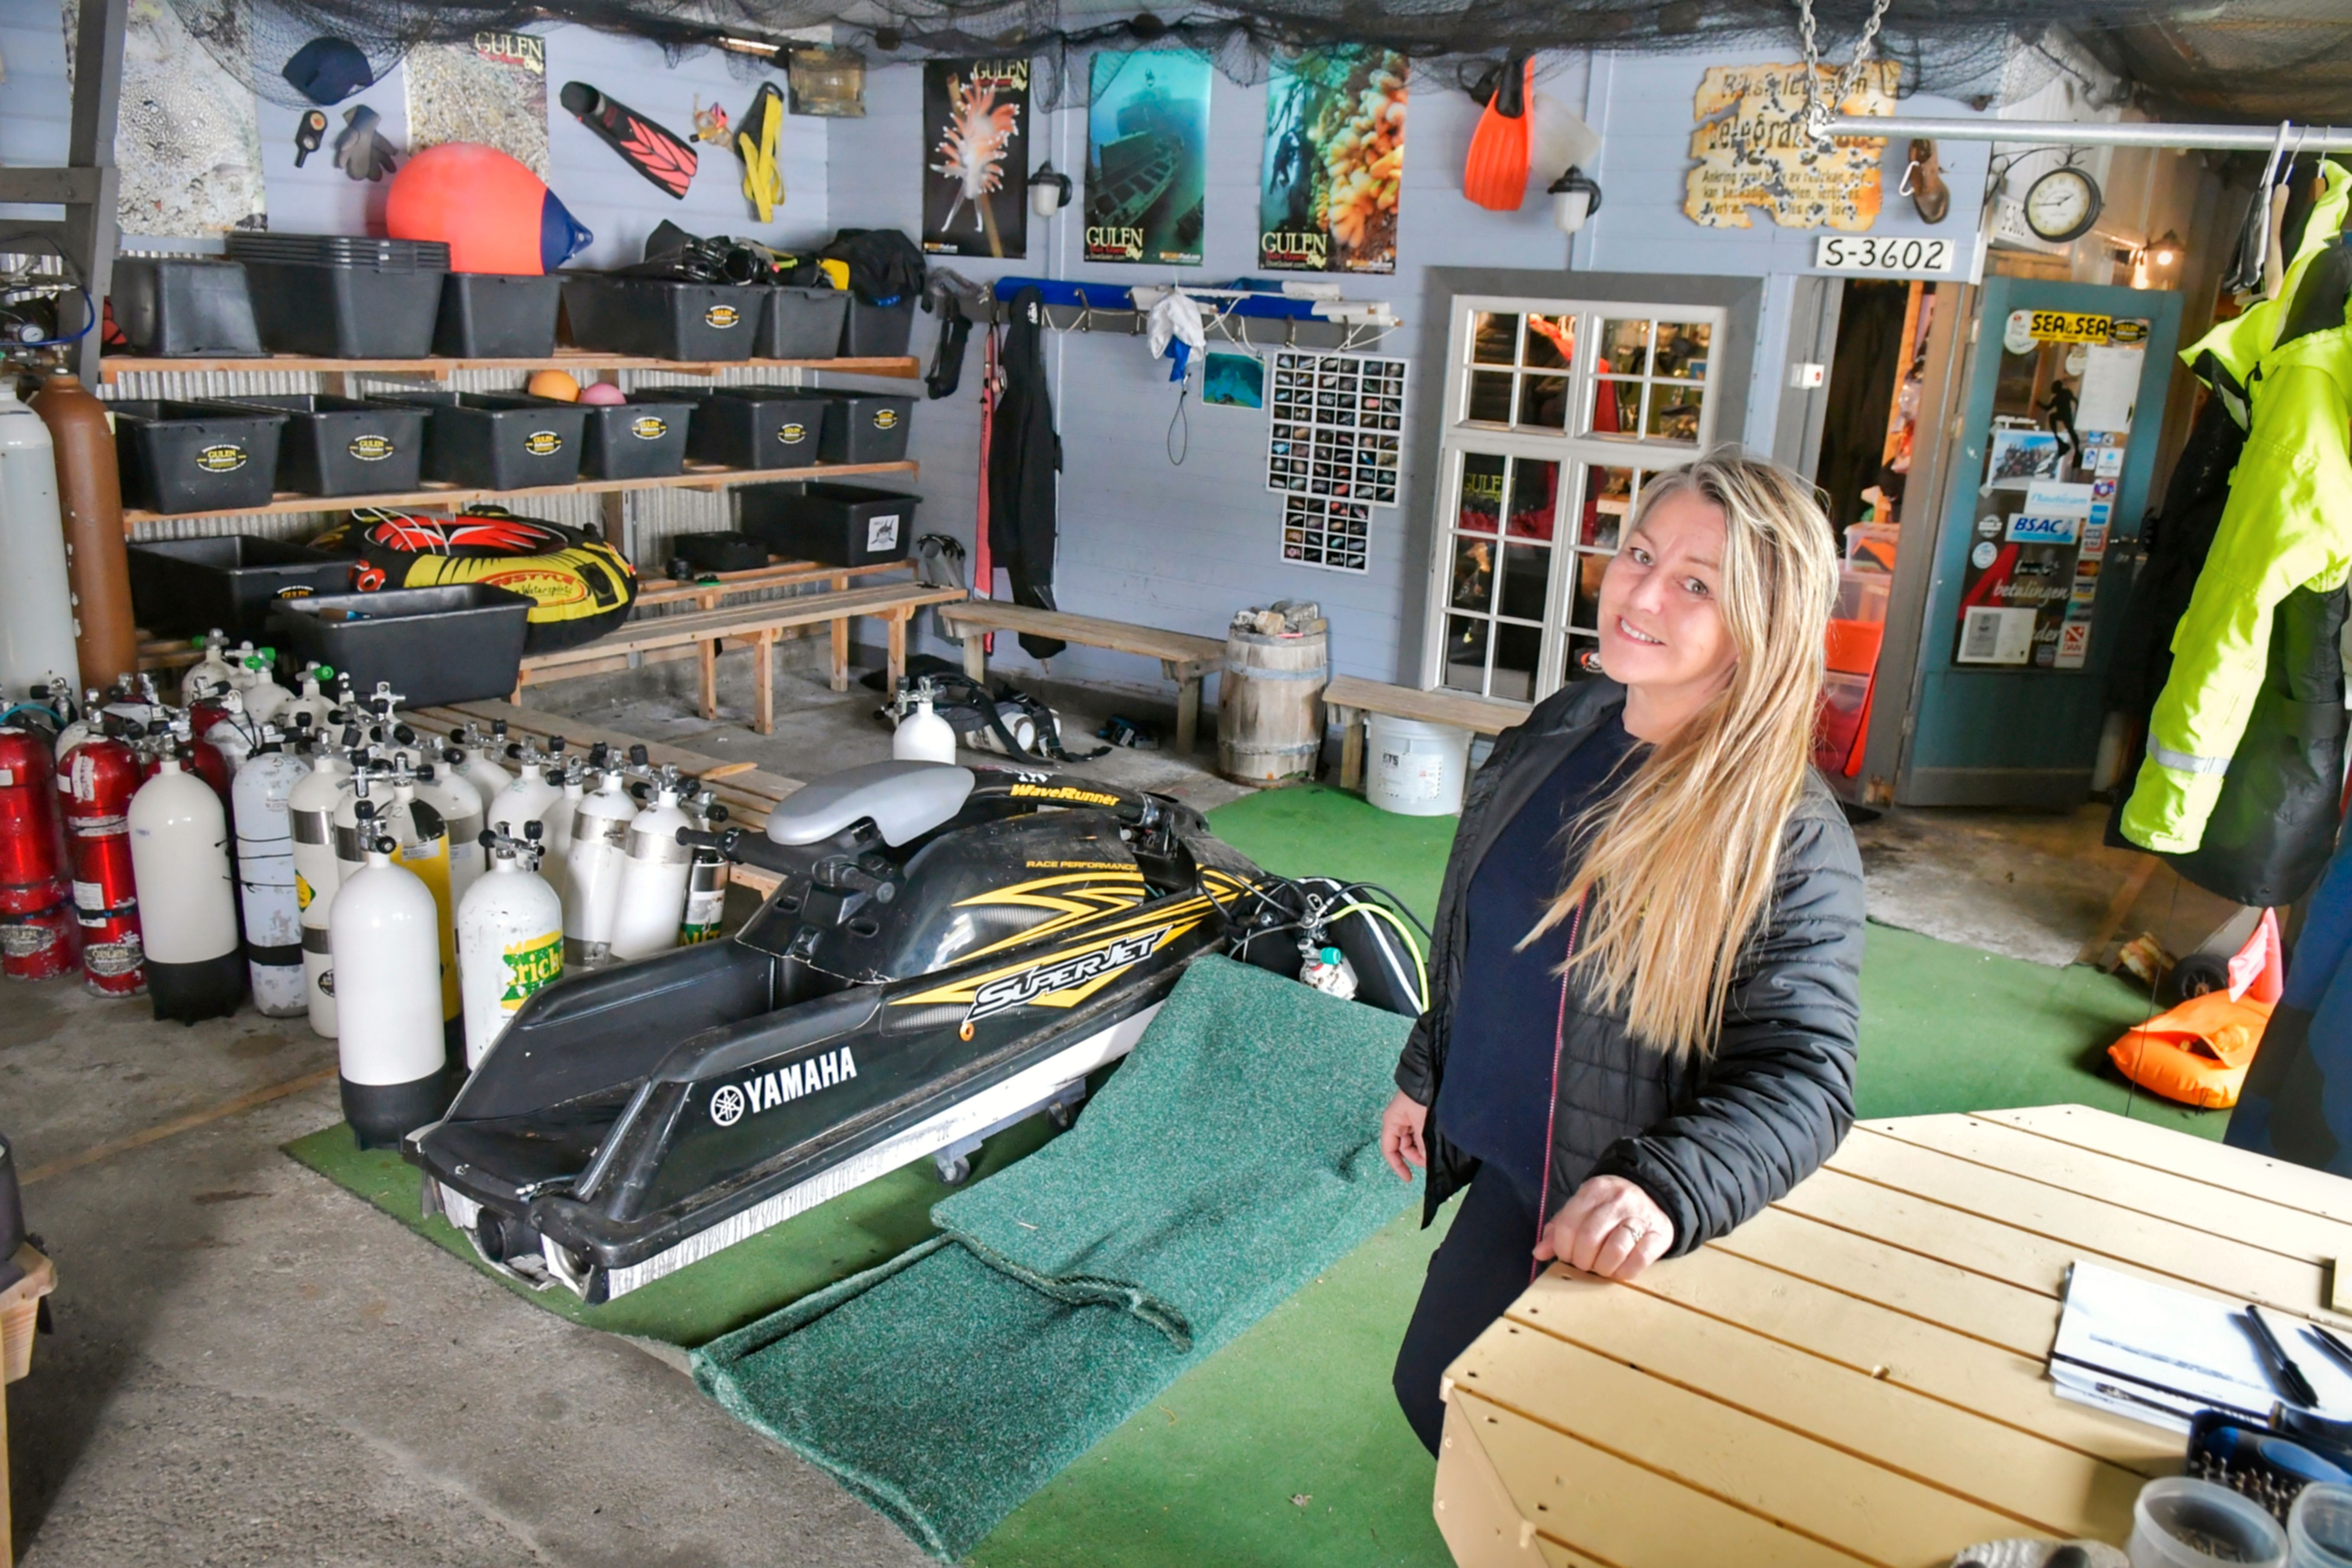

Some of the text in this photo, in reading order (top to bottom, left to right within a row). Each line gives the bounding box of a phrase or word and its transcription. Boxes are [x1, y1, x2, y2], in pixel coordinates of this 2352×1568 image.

[475, 31, 544, 61] GULEN
[1086, 226, 1144, 248] GULEN
[1261, 231, 1328, 255] GULEN
[1825, 239, 1944, 270] S-3602
[2031, 314, 2065, 333] SEA
[2074, 317, 2108, 336] SEA
[2014, 517, 2062, 533] BSAC
[1010, 784, 1121, 807] WaveRunner
[1060, 860, 1138, 871] PERFORMANCE
[743, 1045, 858, 1114] YAMAHA
